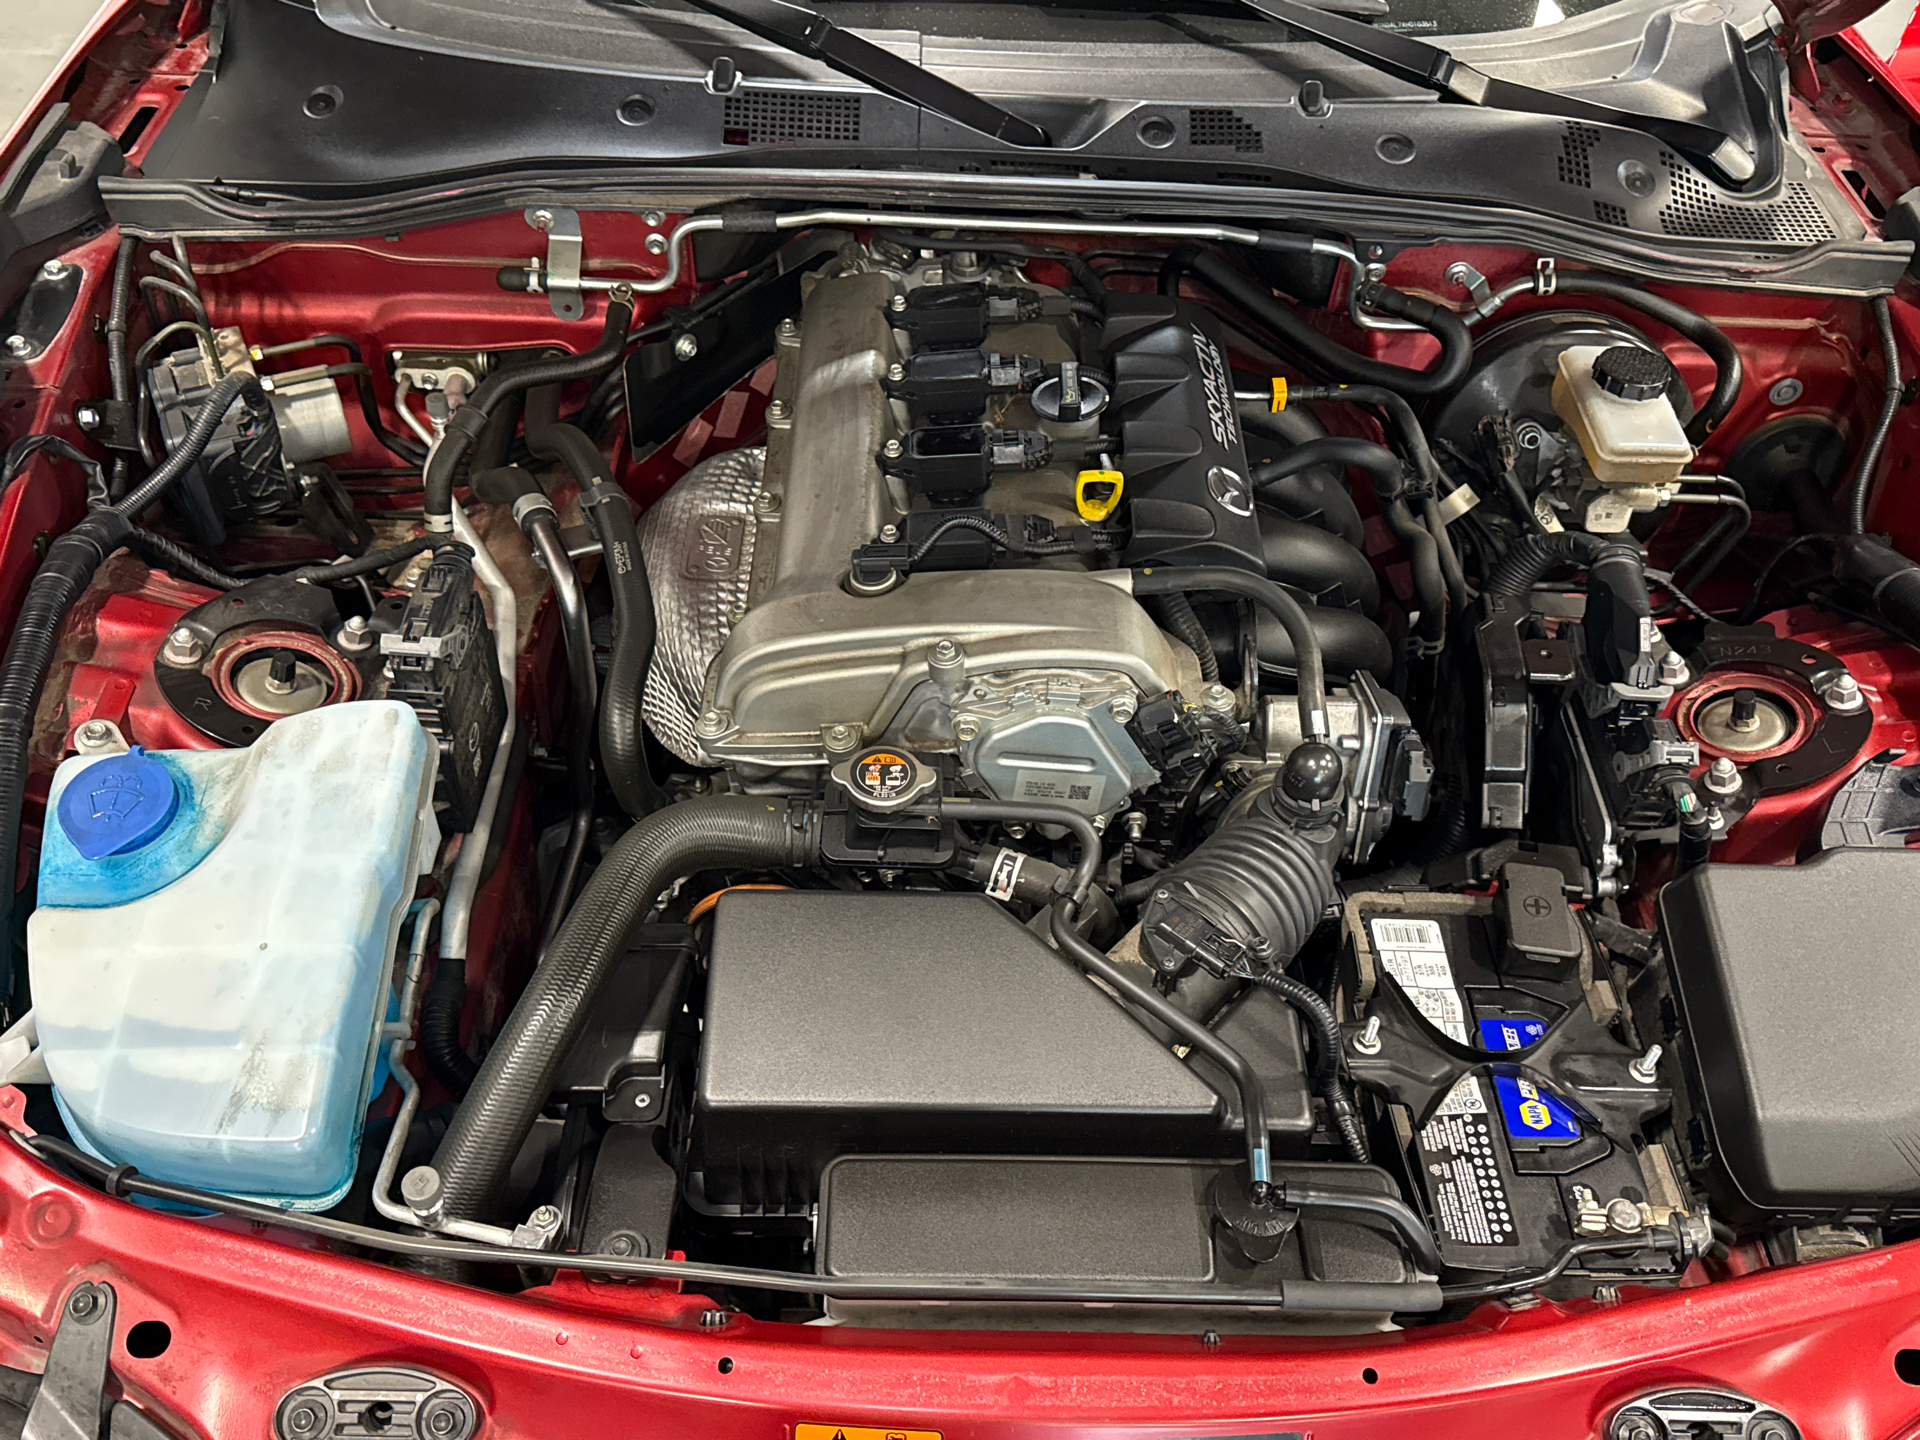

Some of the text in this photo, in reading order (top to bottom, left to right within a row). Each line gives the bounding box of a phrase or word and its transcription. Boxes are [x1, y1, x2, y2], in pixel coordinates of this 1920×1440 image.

[1189, 321, 1229, 452] SKYACTIV
[1208, 338, 1238, 445] TECHNOLOGY
[1719, 644, 1772, 656] N243
[193, 697, 213, 711] R
[1527, 1104, 1544, 1125] NAPA
